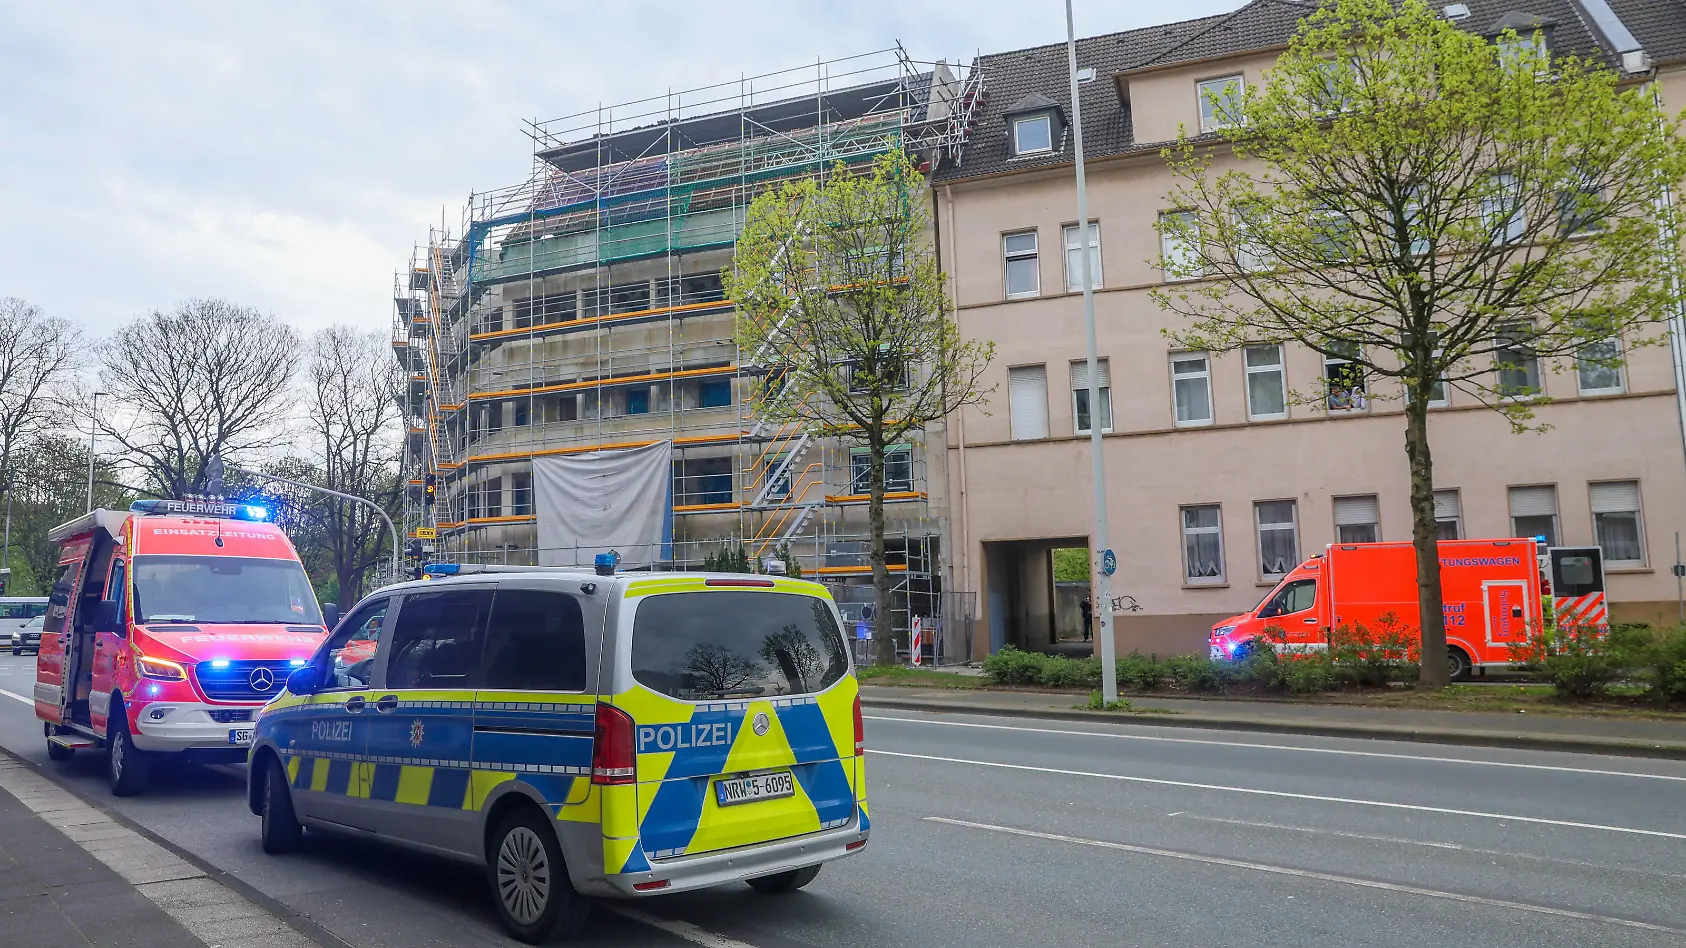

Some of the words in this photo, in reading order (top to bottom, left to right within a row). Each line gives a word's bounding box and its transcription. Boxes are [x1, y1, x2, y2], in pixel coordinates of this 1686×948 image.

[167, 502, 236, 515] FEUERWEHR
[153, 529, 275, 540] EINSATZLEITUNG
[1438, 557, 1520, 567] TUNGSWAGEN
[1443, 603, 1465, 613] truf
[180, 634, 316, 643] FEUERWEHR
[312, 721, 352, 741] POLIZEI
[639, 722, 731, 750] POLIZEI
[724, 780, 747, 800] NRW
[752, 775, 792, 796] 5-6095
